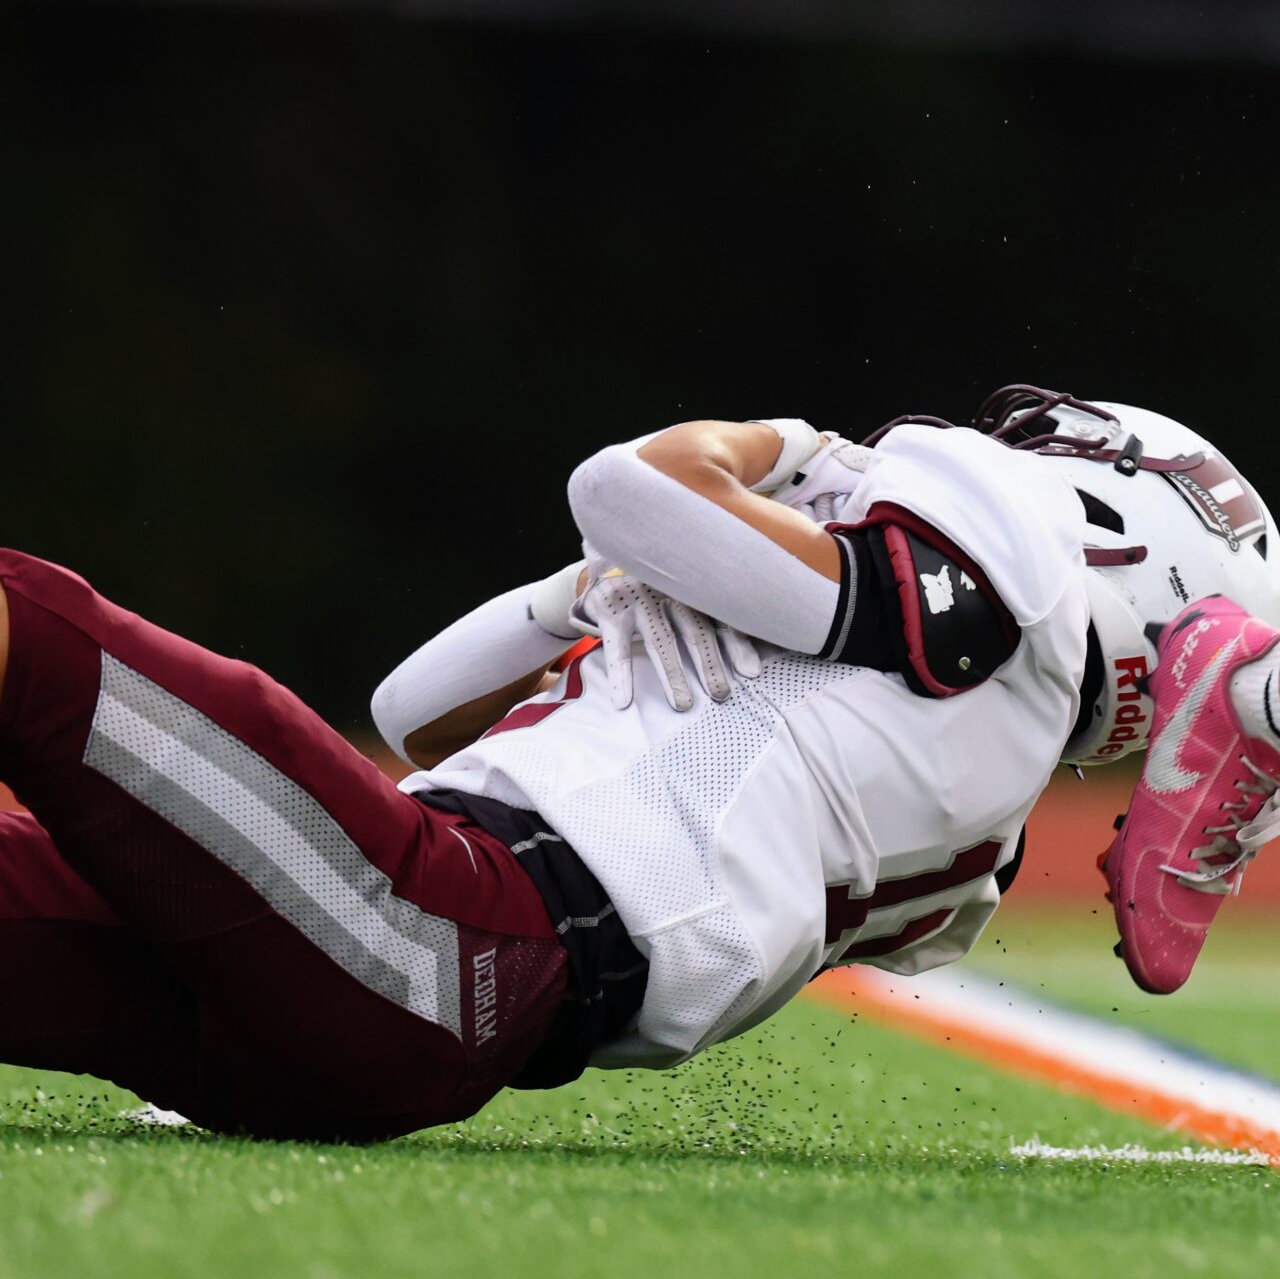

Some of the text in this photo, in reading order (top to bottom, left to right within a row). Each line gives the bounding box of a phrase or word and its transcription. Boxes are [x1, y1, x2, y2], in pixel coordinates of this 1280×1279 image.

[1169, 471, 1239, 551] arauders
[1097, 655, 1148, 755] Ridde
[473, 947, 497, 1047] DEDHAM
